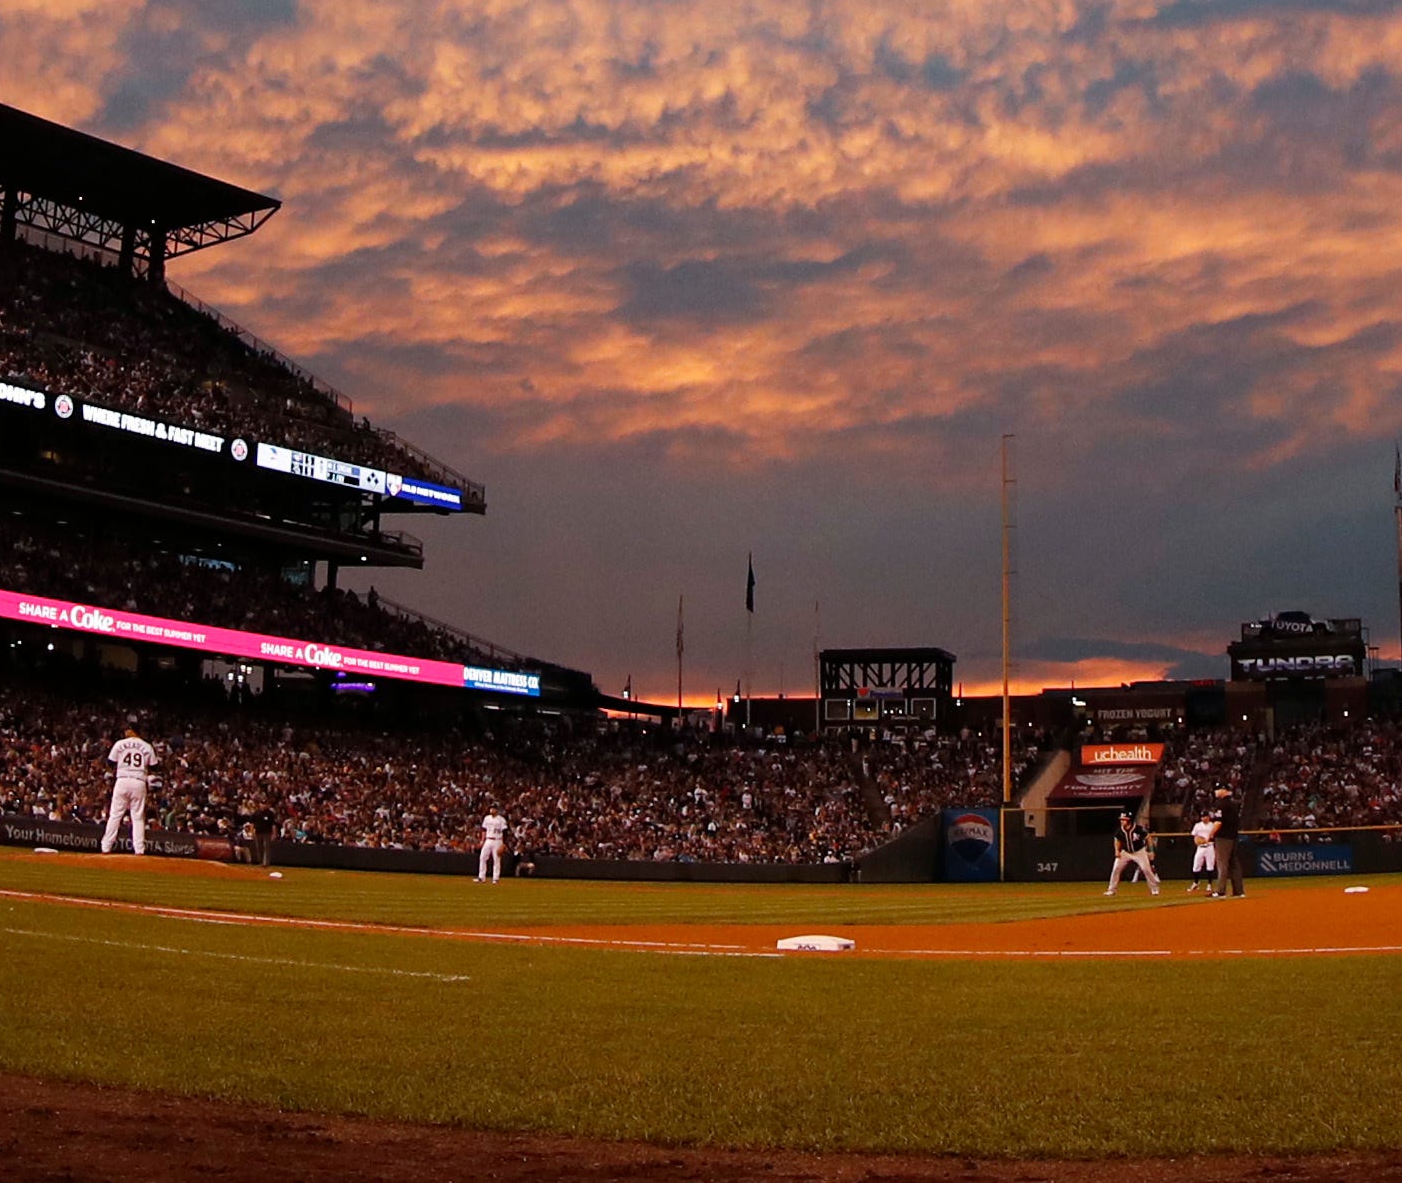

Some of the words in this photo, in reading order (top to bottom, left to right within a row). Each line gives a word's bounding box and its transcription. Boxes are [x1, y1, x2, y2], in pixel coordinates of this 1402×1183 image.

[83, 404, 120, 428] WHERE
[121, 414, 155, 436] FRESH
[155, 423, 167, 439] &
[169, 426, 195, 446] FAST
[18, 602, 58, 620] SHARE
[59, 610, 69, 622] A
[70, 605, 115, 632] Coke
[116, 620, 132, 631] FOR
[132, 623, 146, 634] THE
[146, 626, 164, 637] BEST
[192, 633, 206, 644] YET
[260, 642, 294, 658] SHARE
[295, 648, 304, 659] A
[304, 643, 341, 667] Coke
[343, 657, 357, 666] FOR
[357, 658, 369, 668] THE
[368, 660, 384, 670] BEST
[408, 666, 420, 675] YET
[1238, 655, 1356, 673] TUNDRA
[1098, 709, 1134, 718] FROZEN
[1135, 708, 1172, 718] YOGURT
[123, 752, 142, 767] 49
[1094, 746, 1152, 761] uchealth
[5, 824, 35, 839] Your
[35, 828, 98, 848] Hometown
[1273, 852, 1314, 862] BURNS
[1037, 863, 1058, 872] 347
